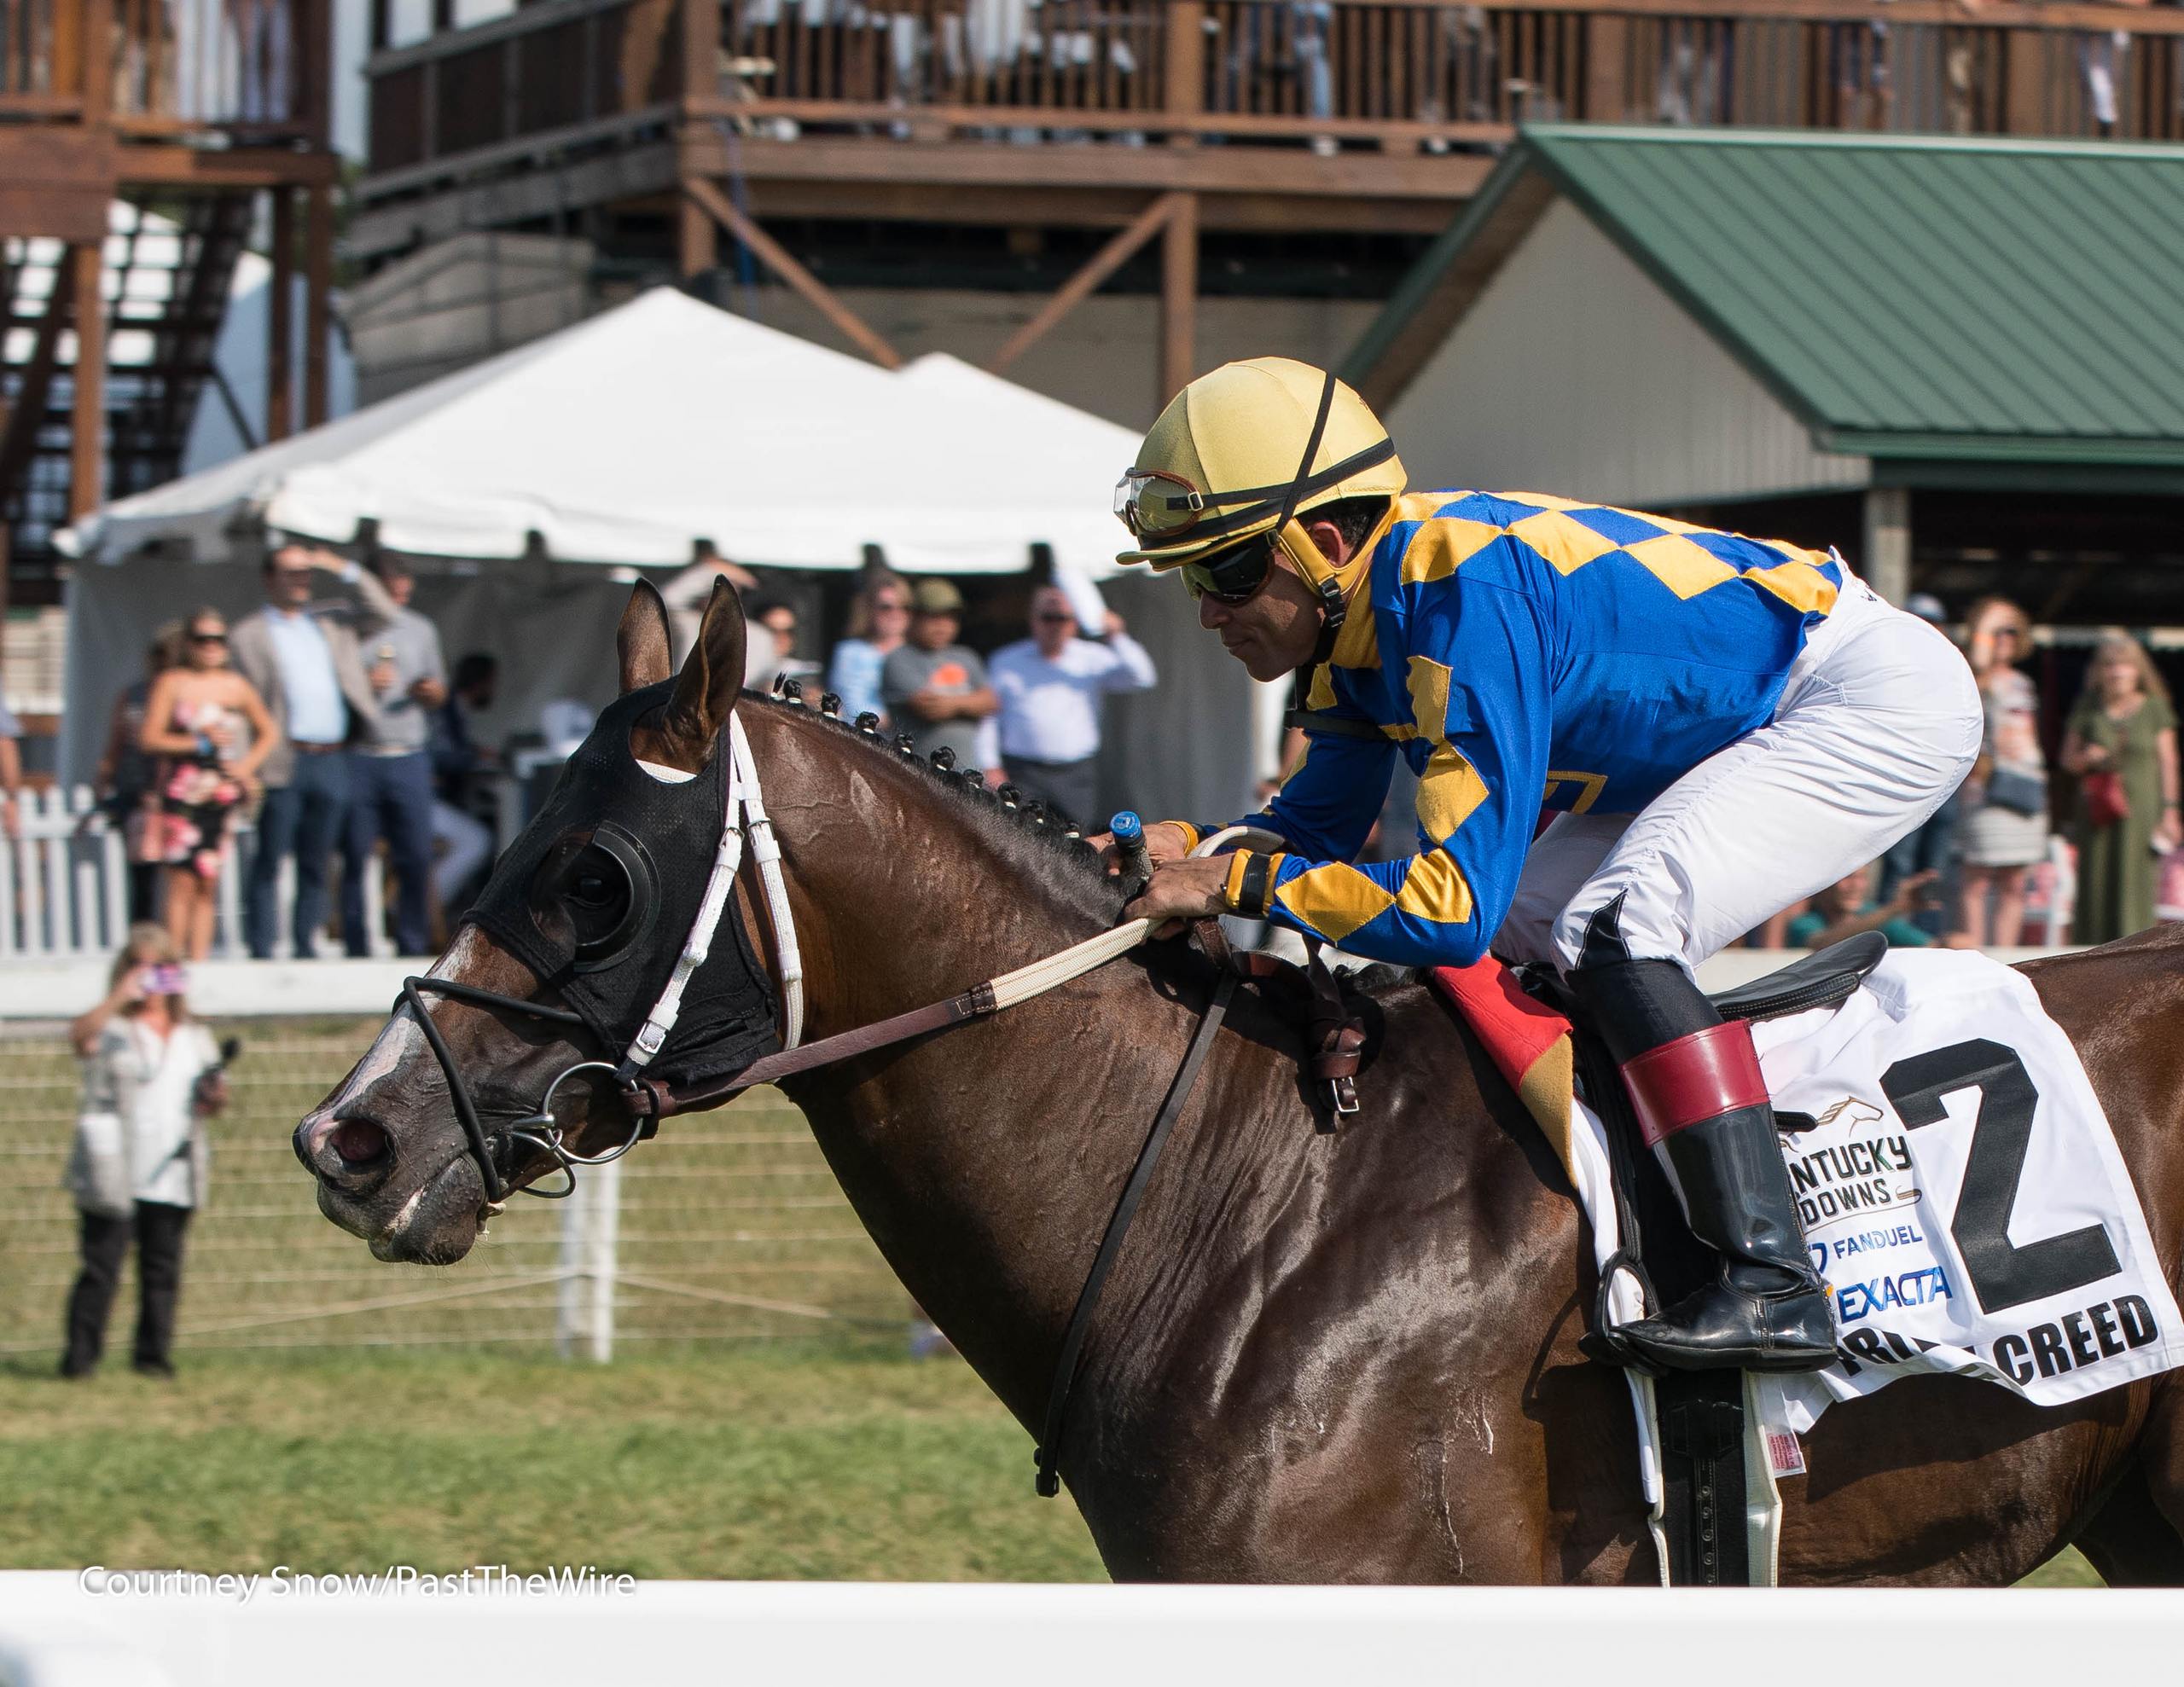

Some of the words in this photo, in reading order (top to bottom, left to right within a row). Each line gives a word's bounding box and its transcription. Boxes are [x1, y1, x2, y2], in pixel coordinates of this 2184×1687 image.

[1789, 1135, 1914, 1199] NTUCKY
[1879, 1037, 2123, 1315] 2
[1799, 1178, 1891, 1226] DOWNS
[1833, 1226, 1923, 1259] FANDUEL
[1837, 1266, 1953, 1324] EXACTA
[1993, 1295, 2158, 1387] CREED
